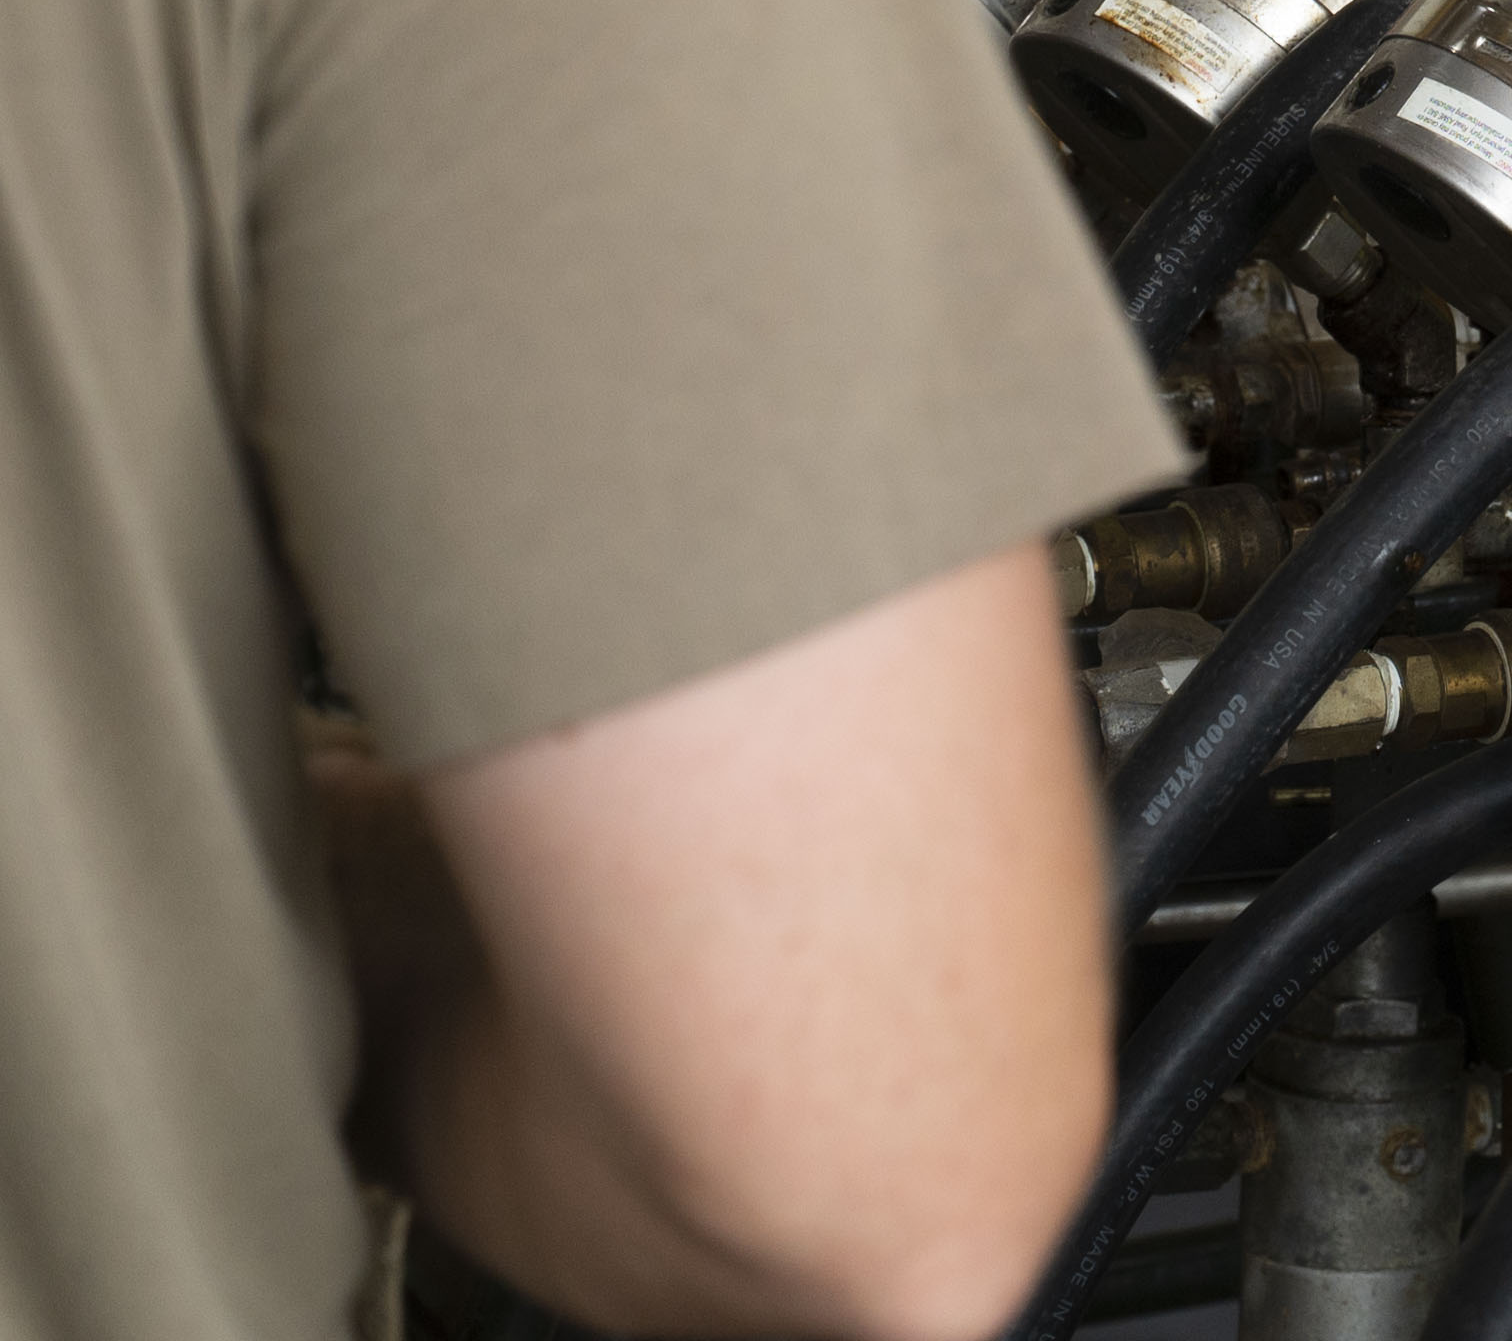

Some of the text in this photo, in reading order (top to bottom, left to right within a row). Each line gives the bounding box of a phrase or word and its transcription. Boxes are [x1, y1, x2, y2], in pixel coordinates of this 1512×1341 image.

[1301, 598, 1329, 625] IN
[1259, 629, 1305, 668] USA
[1140, 693, 1249, 827] GOODYEAR
[1311, 938, 1339, 974] 3/4"
[1226, 979, 1300, 1061] (19.1mm)
[1185, 1077, 1216, 1112] 150
[1153, 1118, 1184, 1157] PSI
[1069, 1224, 1114, 1288] MADE
[1051, 1297, 1073, 1323] IN
